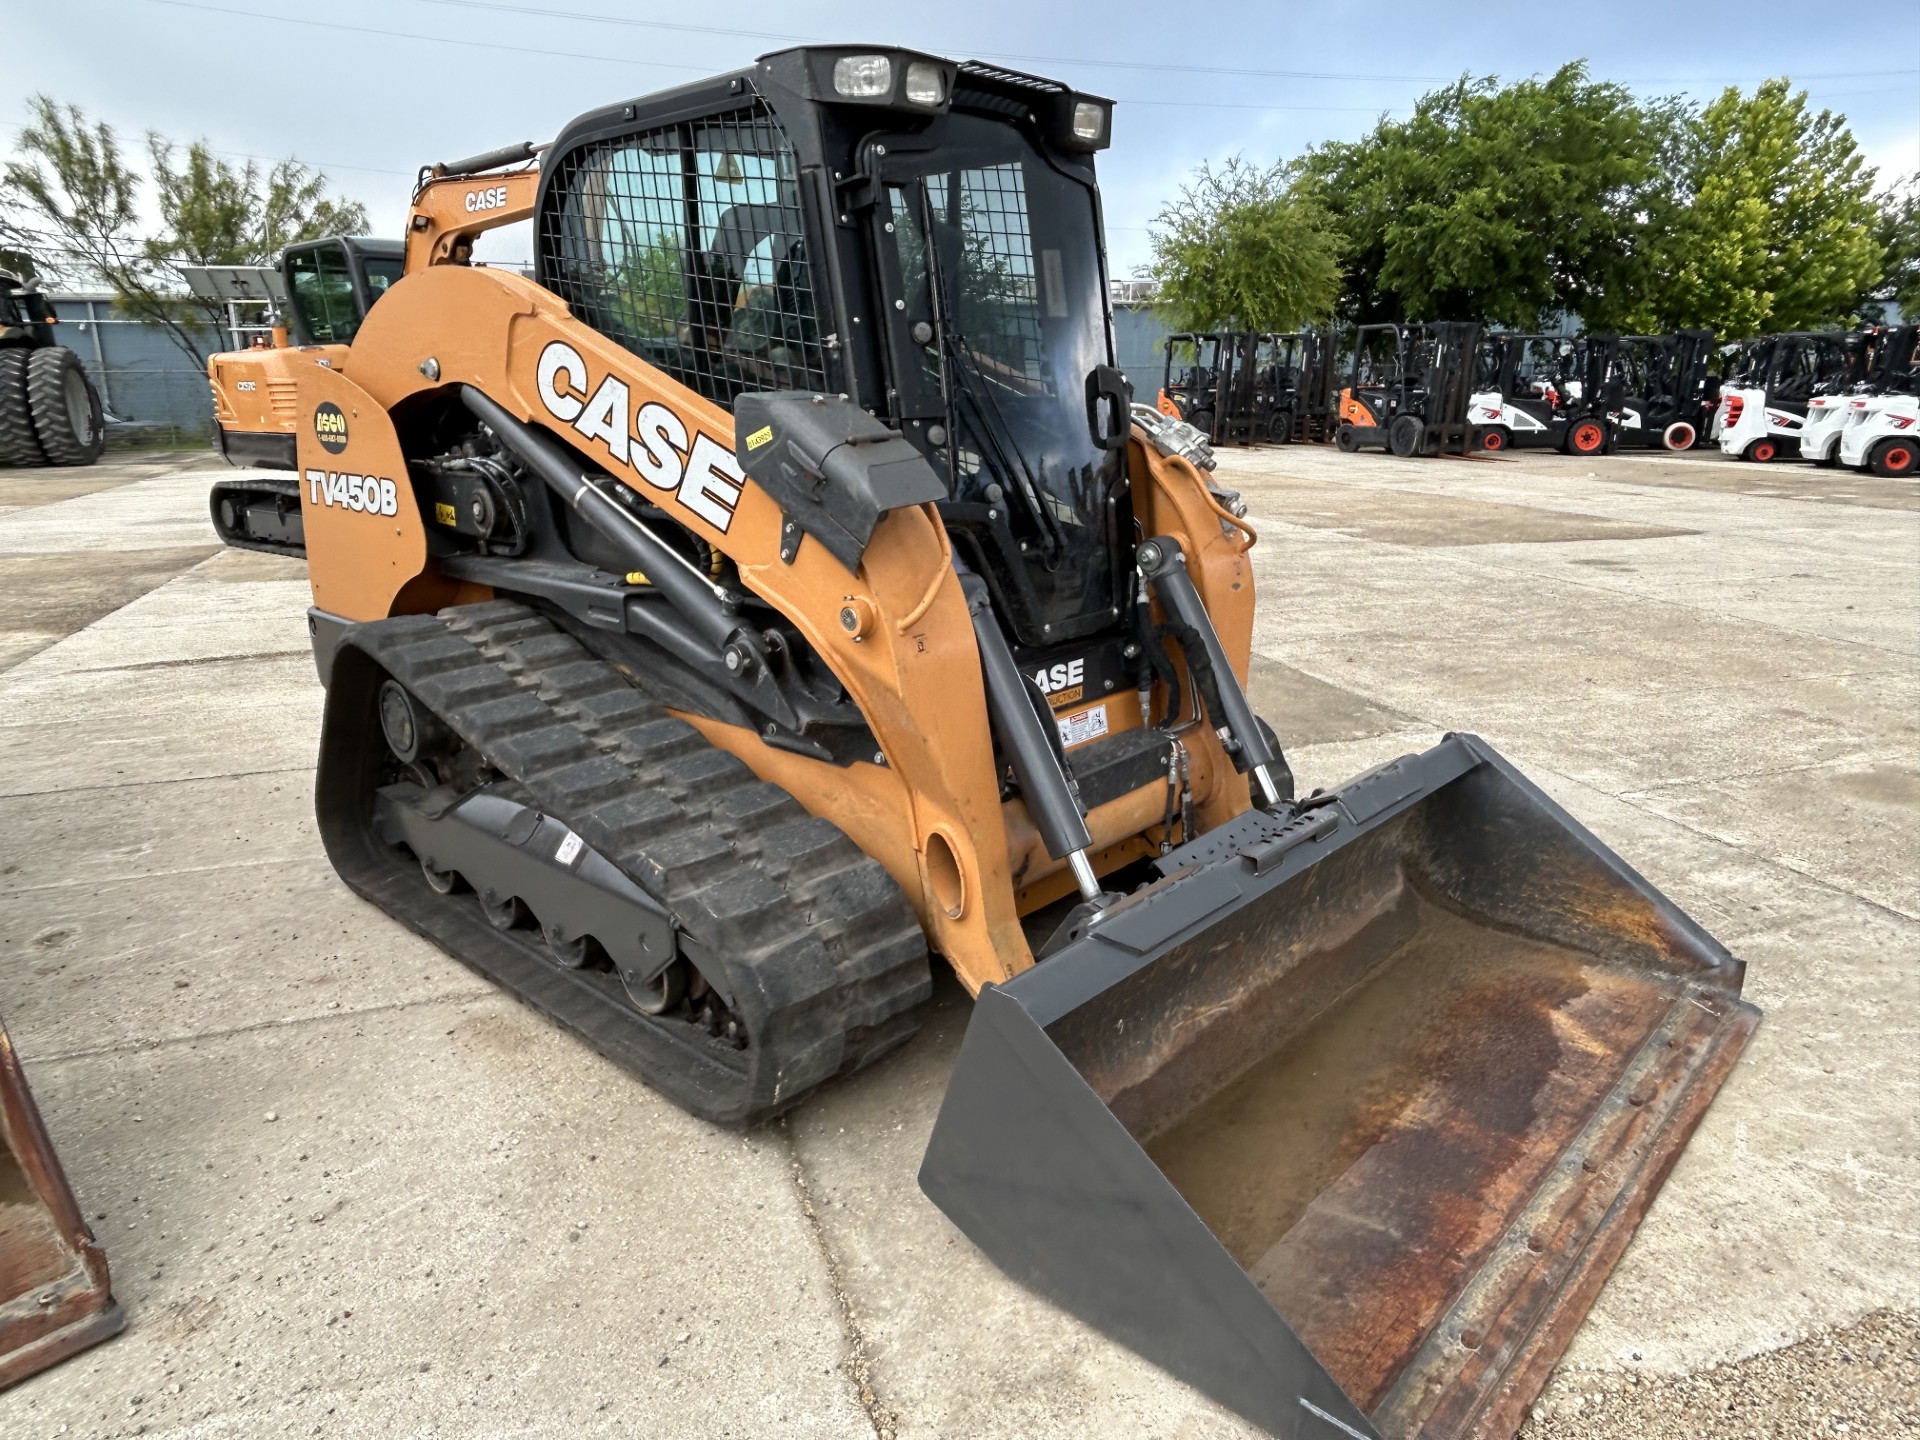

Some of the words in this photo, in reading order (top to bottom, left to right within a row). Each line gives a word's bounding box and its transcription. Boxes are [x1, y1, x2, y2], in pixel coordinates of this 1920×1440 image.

[465, 187, 507, 212] CASE
[537, 340, 747, 535] CASE
[305, 468, 398, 517] TV450B
[1034, 658, 1084, 694] ASE
